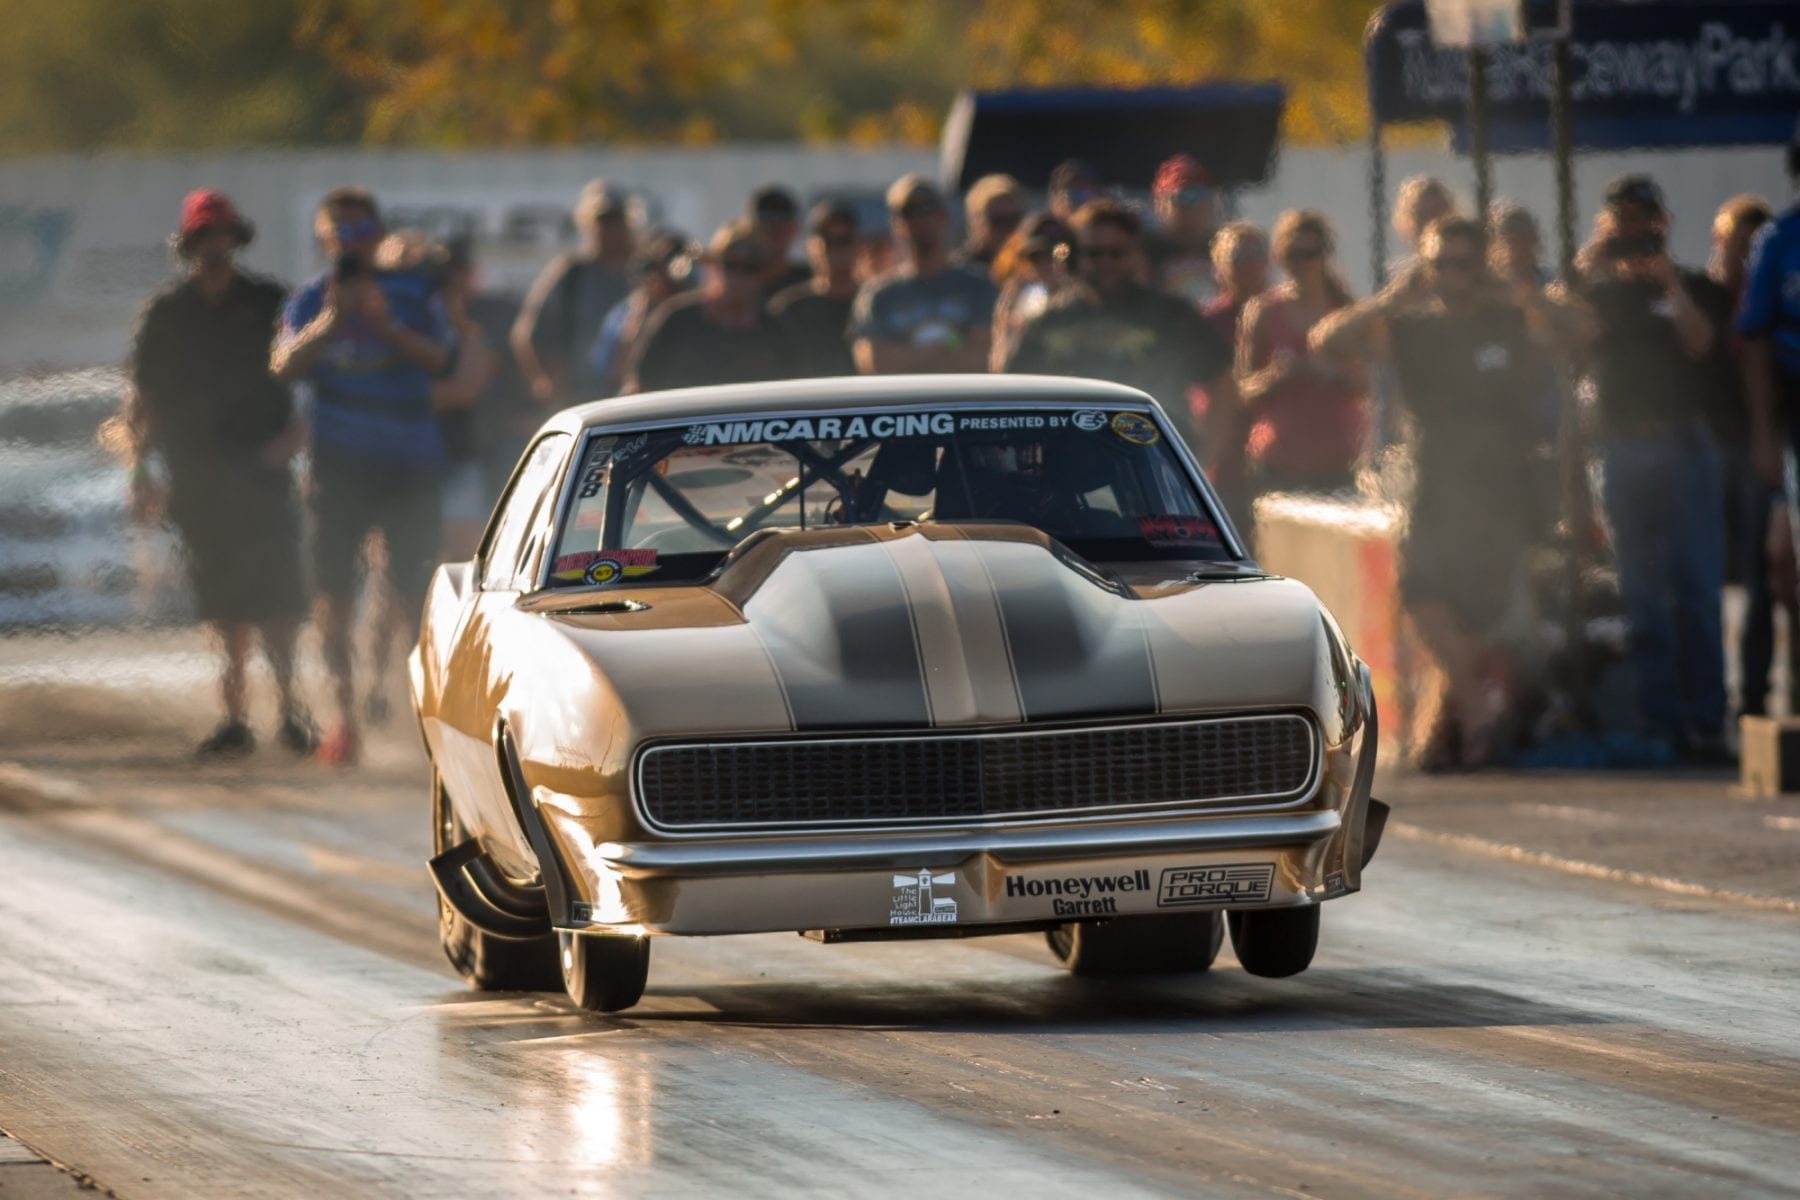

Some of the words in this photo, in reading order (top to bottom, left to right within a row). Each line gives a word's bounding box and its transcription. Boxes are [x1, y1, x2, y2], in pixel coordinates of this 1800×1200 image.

[960, 416, 1044, 430] PRESENTED
[1050, 416, 1068, 428] BY
[1006, 869, 1151, 898] Honeywell
[1169, 870, 1227, 884] PRO
[901, 887, 917, 895] The
[1165, 880, 1268, 898] TORQUE
[893, 894, 917, 903] Little
[895, 901, 917, 910] Light
[1053, 896, 1118, 917] Garrett
